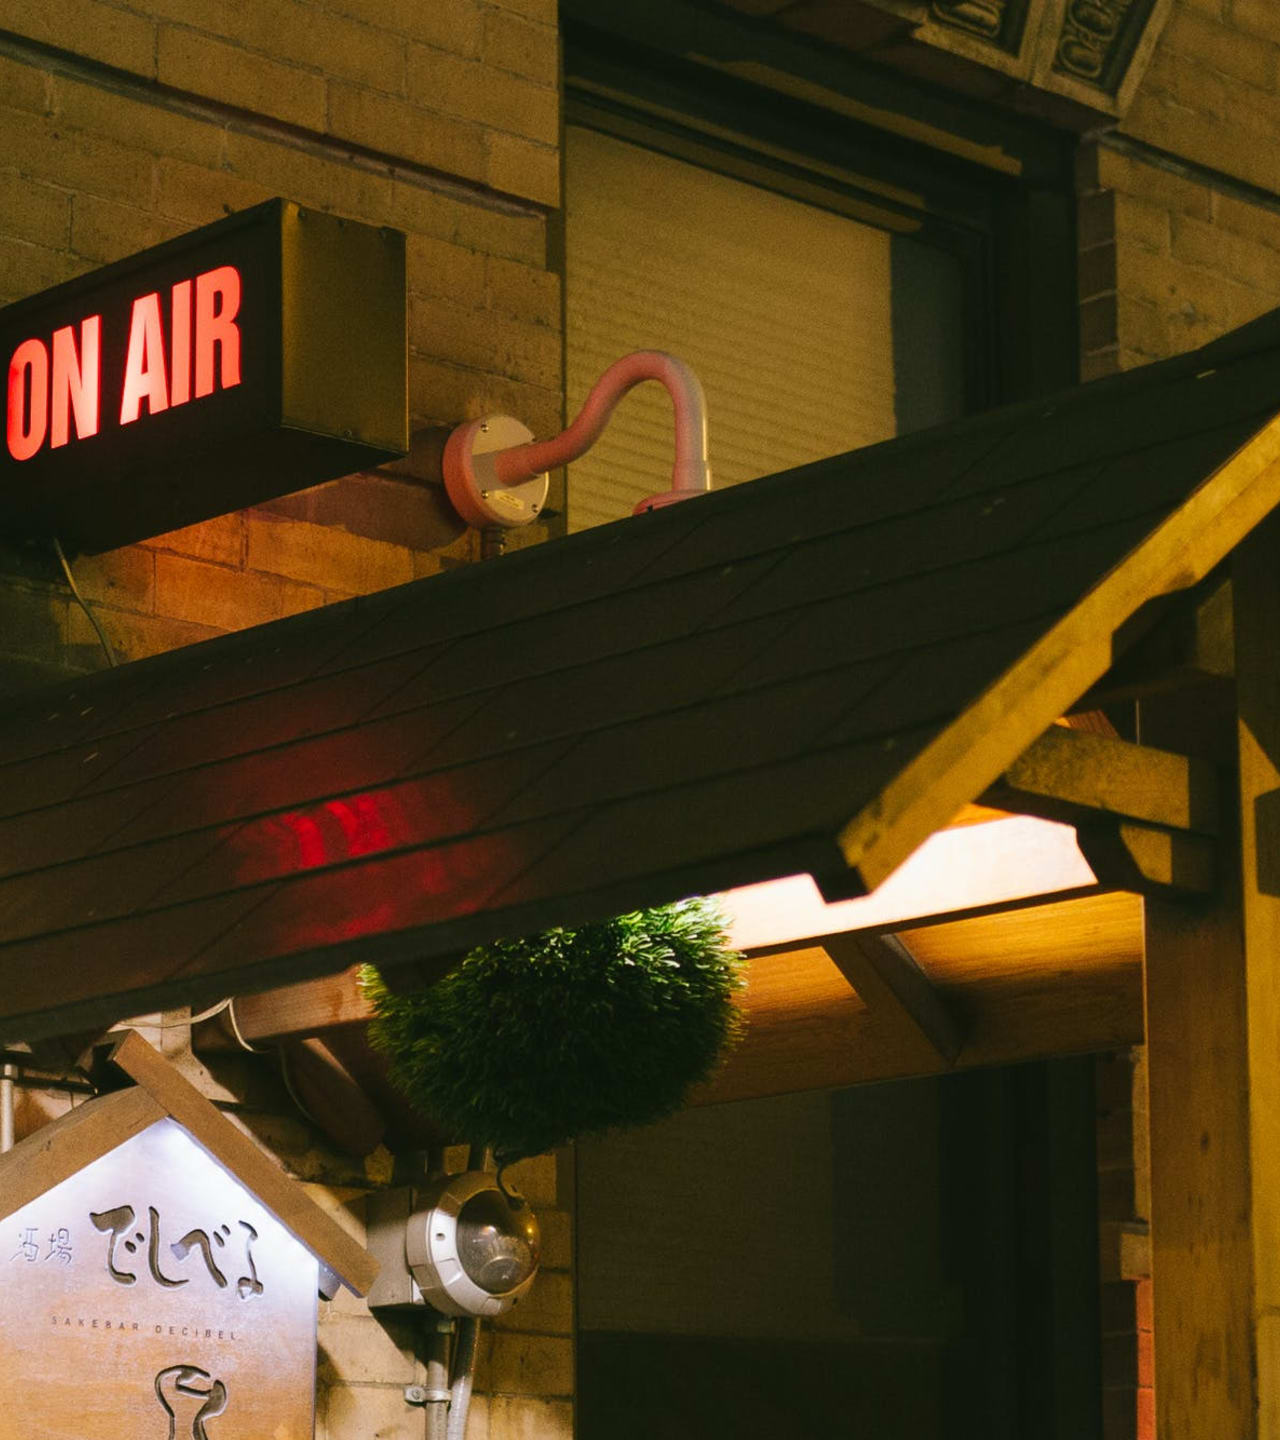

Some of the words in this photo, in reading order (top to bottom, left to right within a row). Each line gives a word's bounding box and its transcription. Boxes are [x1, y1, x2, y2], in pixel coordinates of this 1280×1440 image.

[6, 314, 102, 461] ON
[119, 265, 242, 426] AIR
[52, 1315, 139, 1331] SAKEBAR
[154, 1324, 237, 1341] DECIBEL
